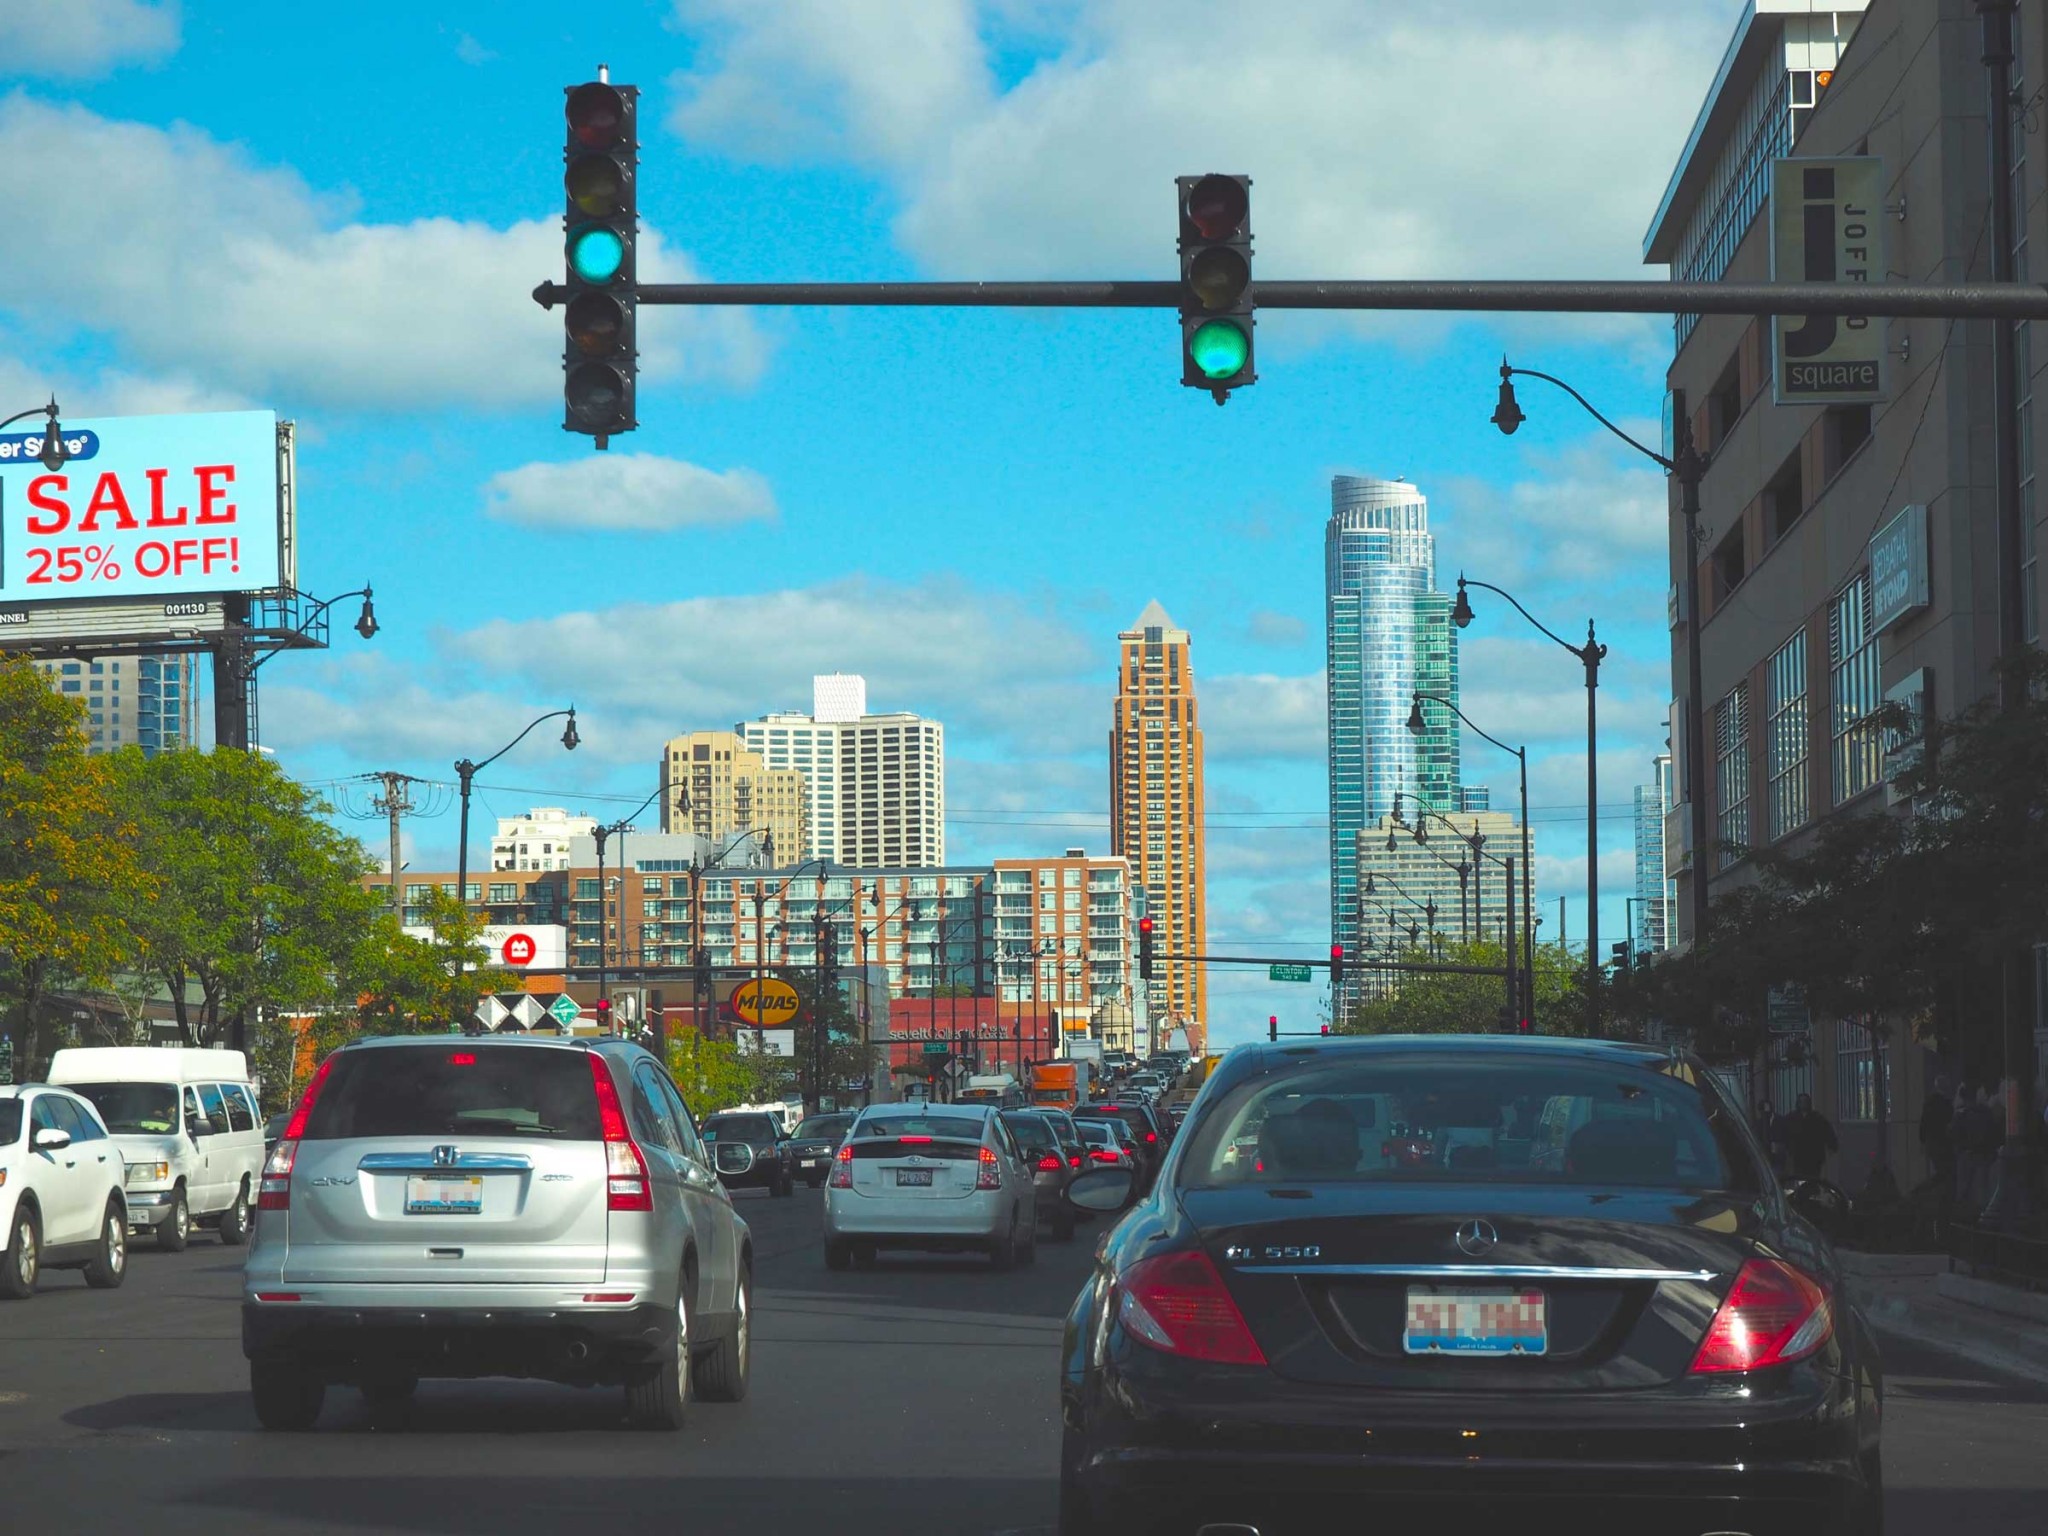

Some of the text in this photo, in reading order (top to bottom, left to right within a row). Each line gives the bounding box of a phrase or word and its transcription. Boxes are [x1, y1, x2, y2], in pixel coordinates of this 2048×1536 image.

[1844, 204, 1868, 330] JOFFO
[1792, 363, 1874, 388] square
[27, 465, 237, 535] SALE
[26, 537, 240, 584] 25% OFF!
[1874, 569, 1909, 618] BEYOND
[166, 603, 205, 615] 001130
[1275, 967, 1303, 975] CLINTON
[738, 995, 798, 1010] MIDAS
[1265, 1246, 1320, 1259] 550
